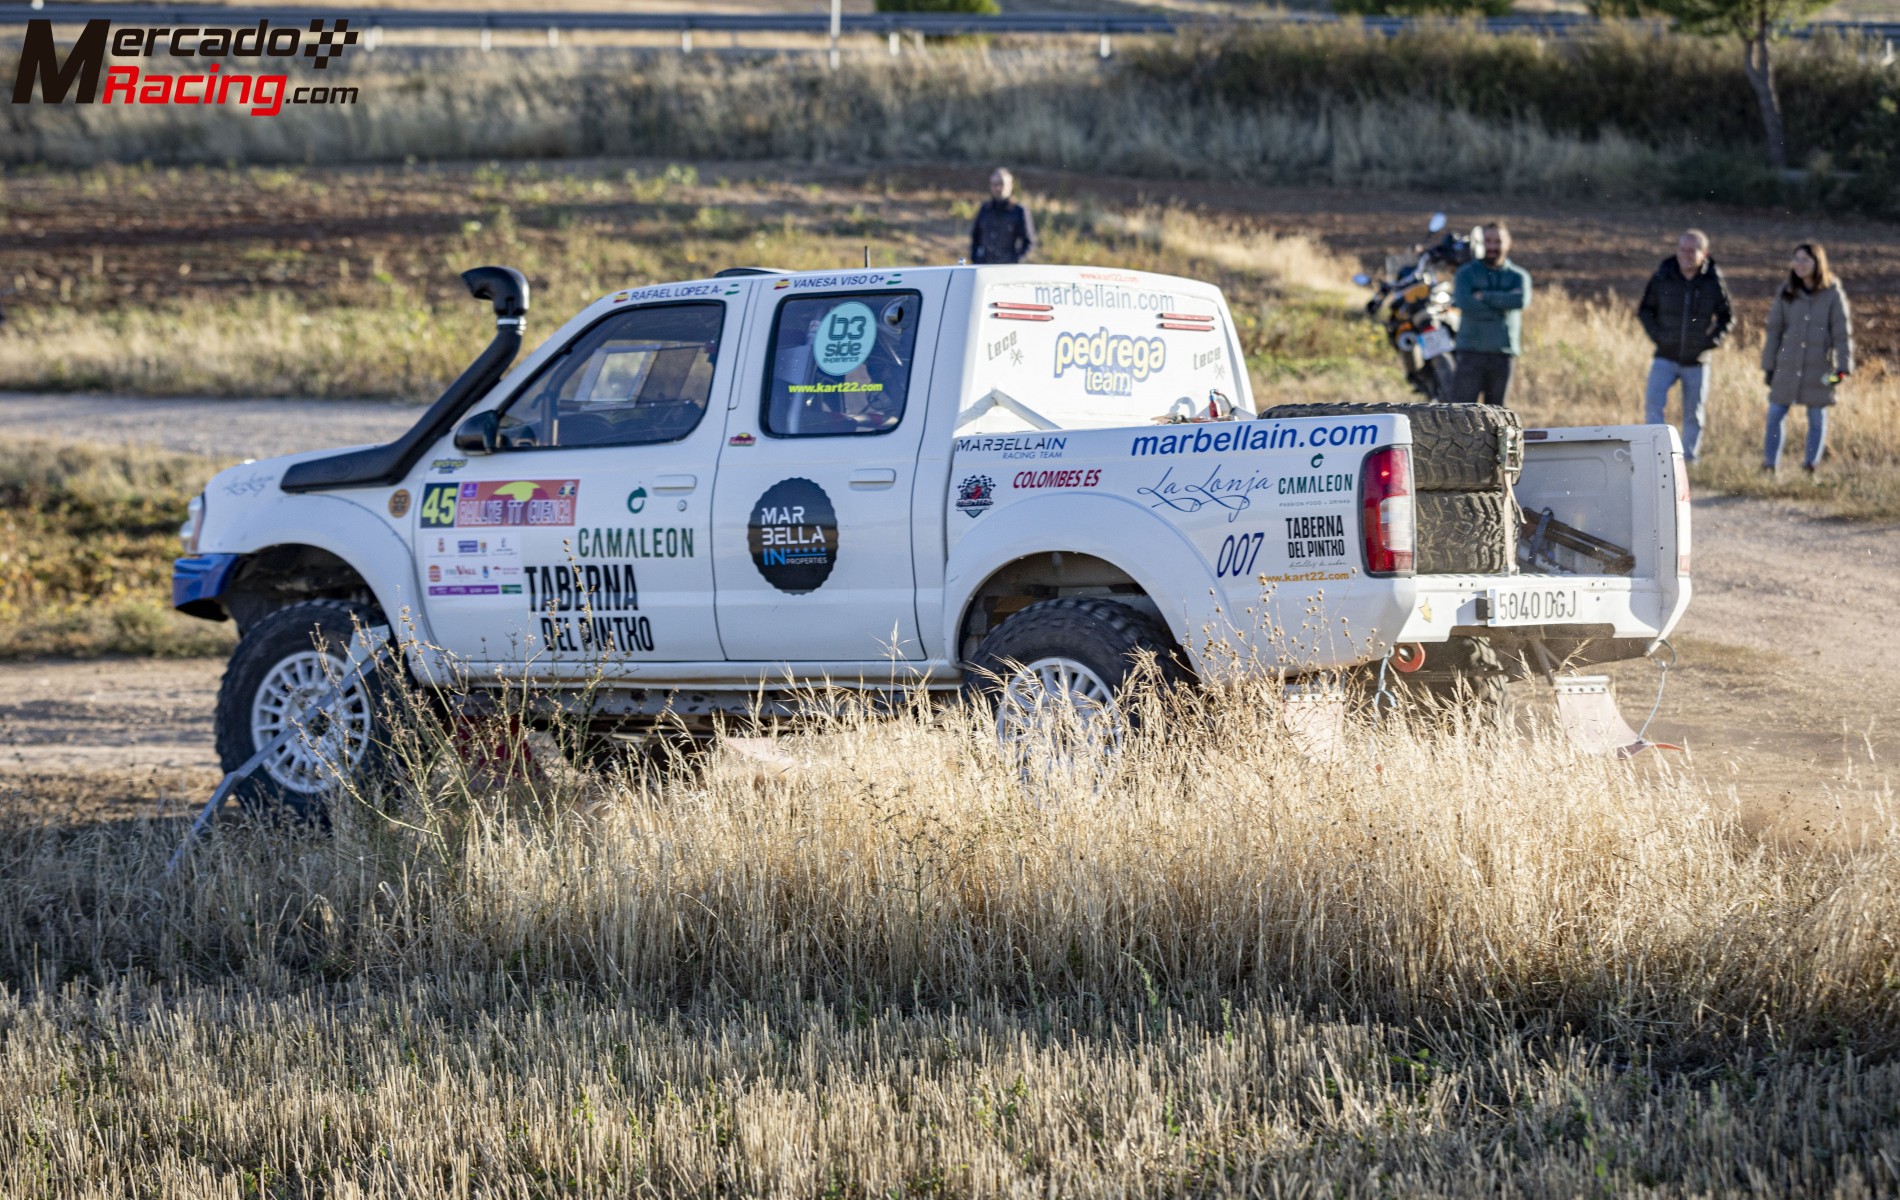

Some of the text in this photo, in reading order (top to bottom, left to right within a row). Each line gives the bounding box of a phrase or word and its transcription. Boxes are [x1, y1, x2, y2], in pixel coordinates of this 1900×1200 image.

[630, 287, 673, 301] RAFAEL
[674, 285, 709, 297] LOPEZ
[793, 276, 837, 288] VANESA
[840, 275, 868, 285] VISO
[1035, 283, 1175, 312] marbellain.com
[824, 340, 862, 357] side
[1054, 326, 1166, 382] pedrega
[788, 381, 883, 394] www.kart22.com
[1085, 366, 1132, 396] team
[957, 437, 1067, 451] MARBELLAIN
[1130, 423, 1378, 456] marbellain.com
[1002, 451, 1062, 460] RACING TEAM
[1137, 464, 1273, 523] La Lonja
[1278, 474, 1353, 495] CAMALEON
[422, 487, 457, 525] 45
[761, 506, 805, 525] MAR
[762, 526, 826, 545] BELLA
[1285, 515, 1345, 539] TABERNA
[578, 528, 694, 558] CAMALEON
[1217, 532, 1265, 578] 007
[1288, 539, 1345, 558] DEL PINTXO
[763, 548, 828, 566] IN PROPERTIES
[523, 564, 639, 612] TABERNA
[1500, 590, 1576, 620] 5040 DGJ
[540, 616, 655, 652] DEL PINTXO
